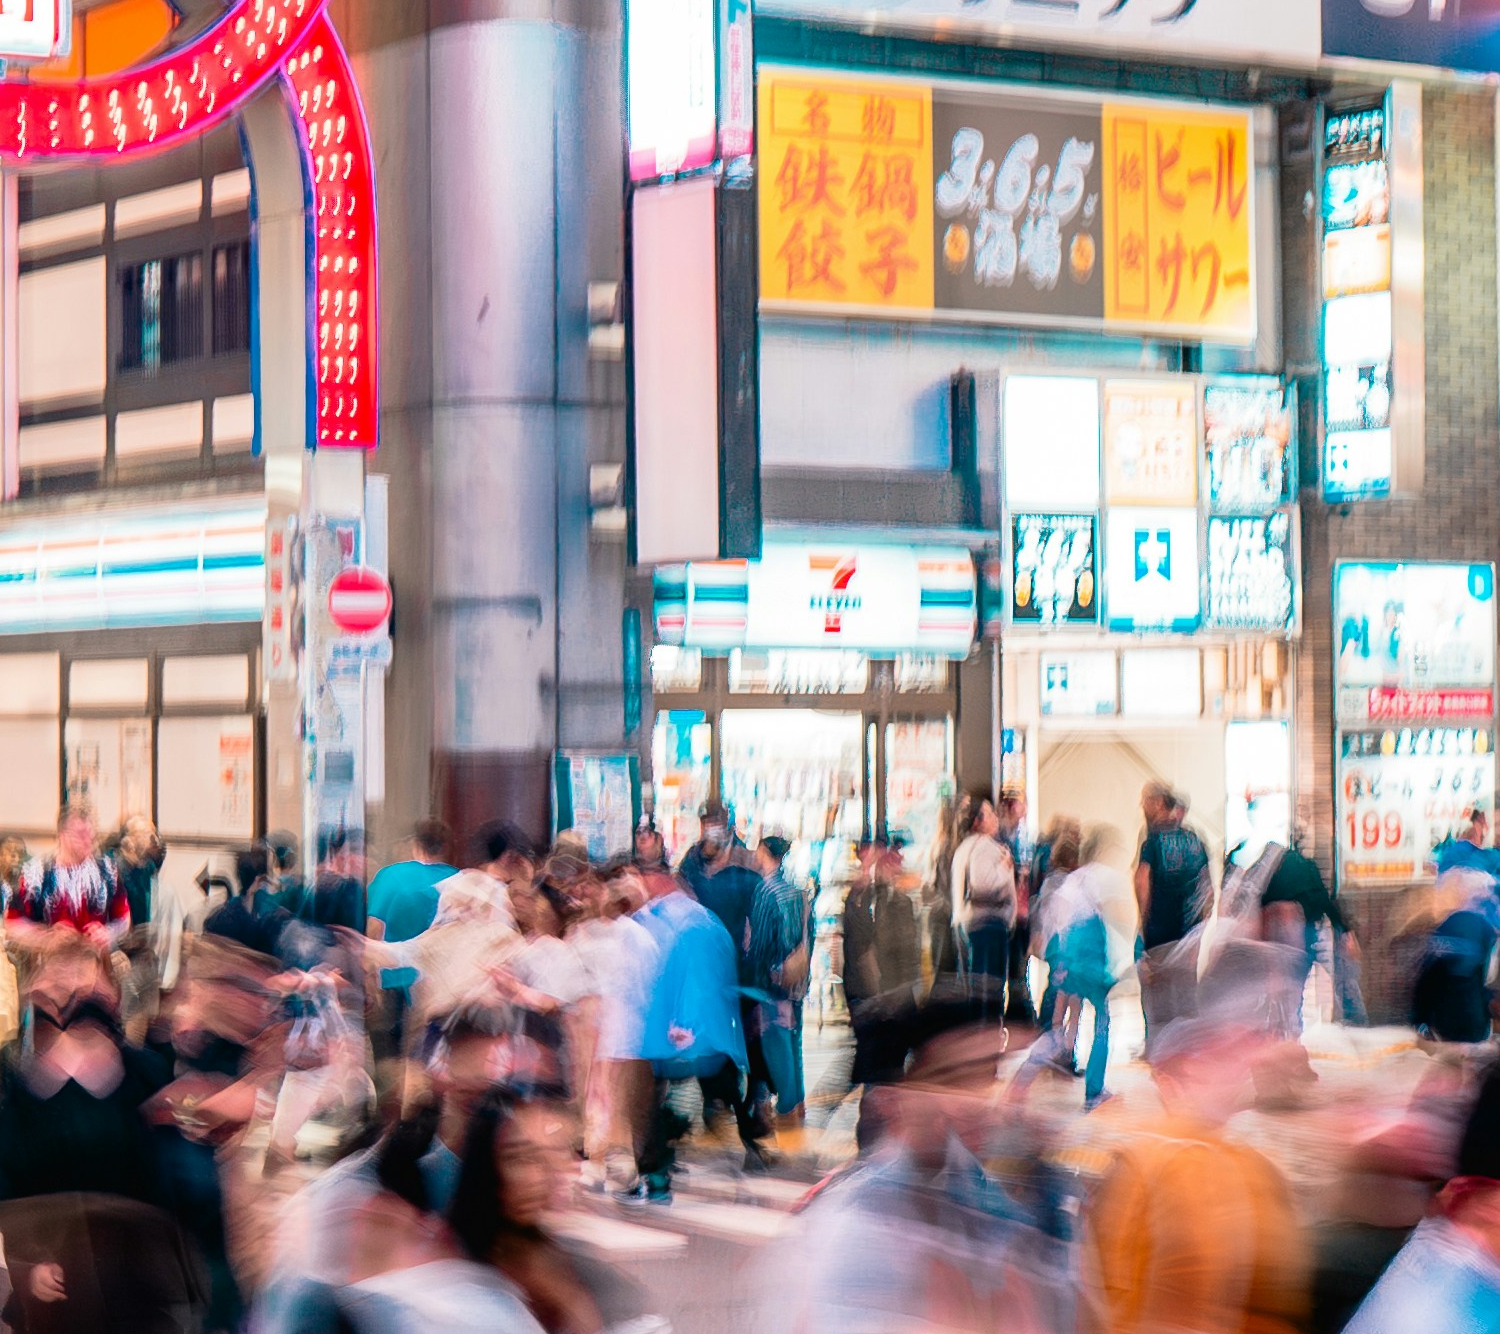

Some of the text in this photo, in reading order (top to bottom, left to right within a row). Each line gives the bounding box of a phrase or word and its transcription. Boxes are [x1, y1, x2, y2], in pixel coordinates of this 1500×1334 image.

[774, 142, 918, 222] 鉄鍋
[1156, 128, 1247, 220] ビール
[776, 219, 918, 298] 餃子
[1156, 232, 1248, 319] サワー
